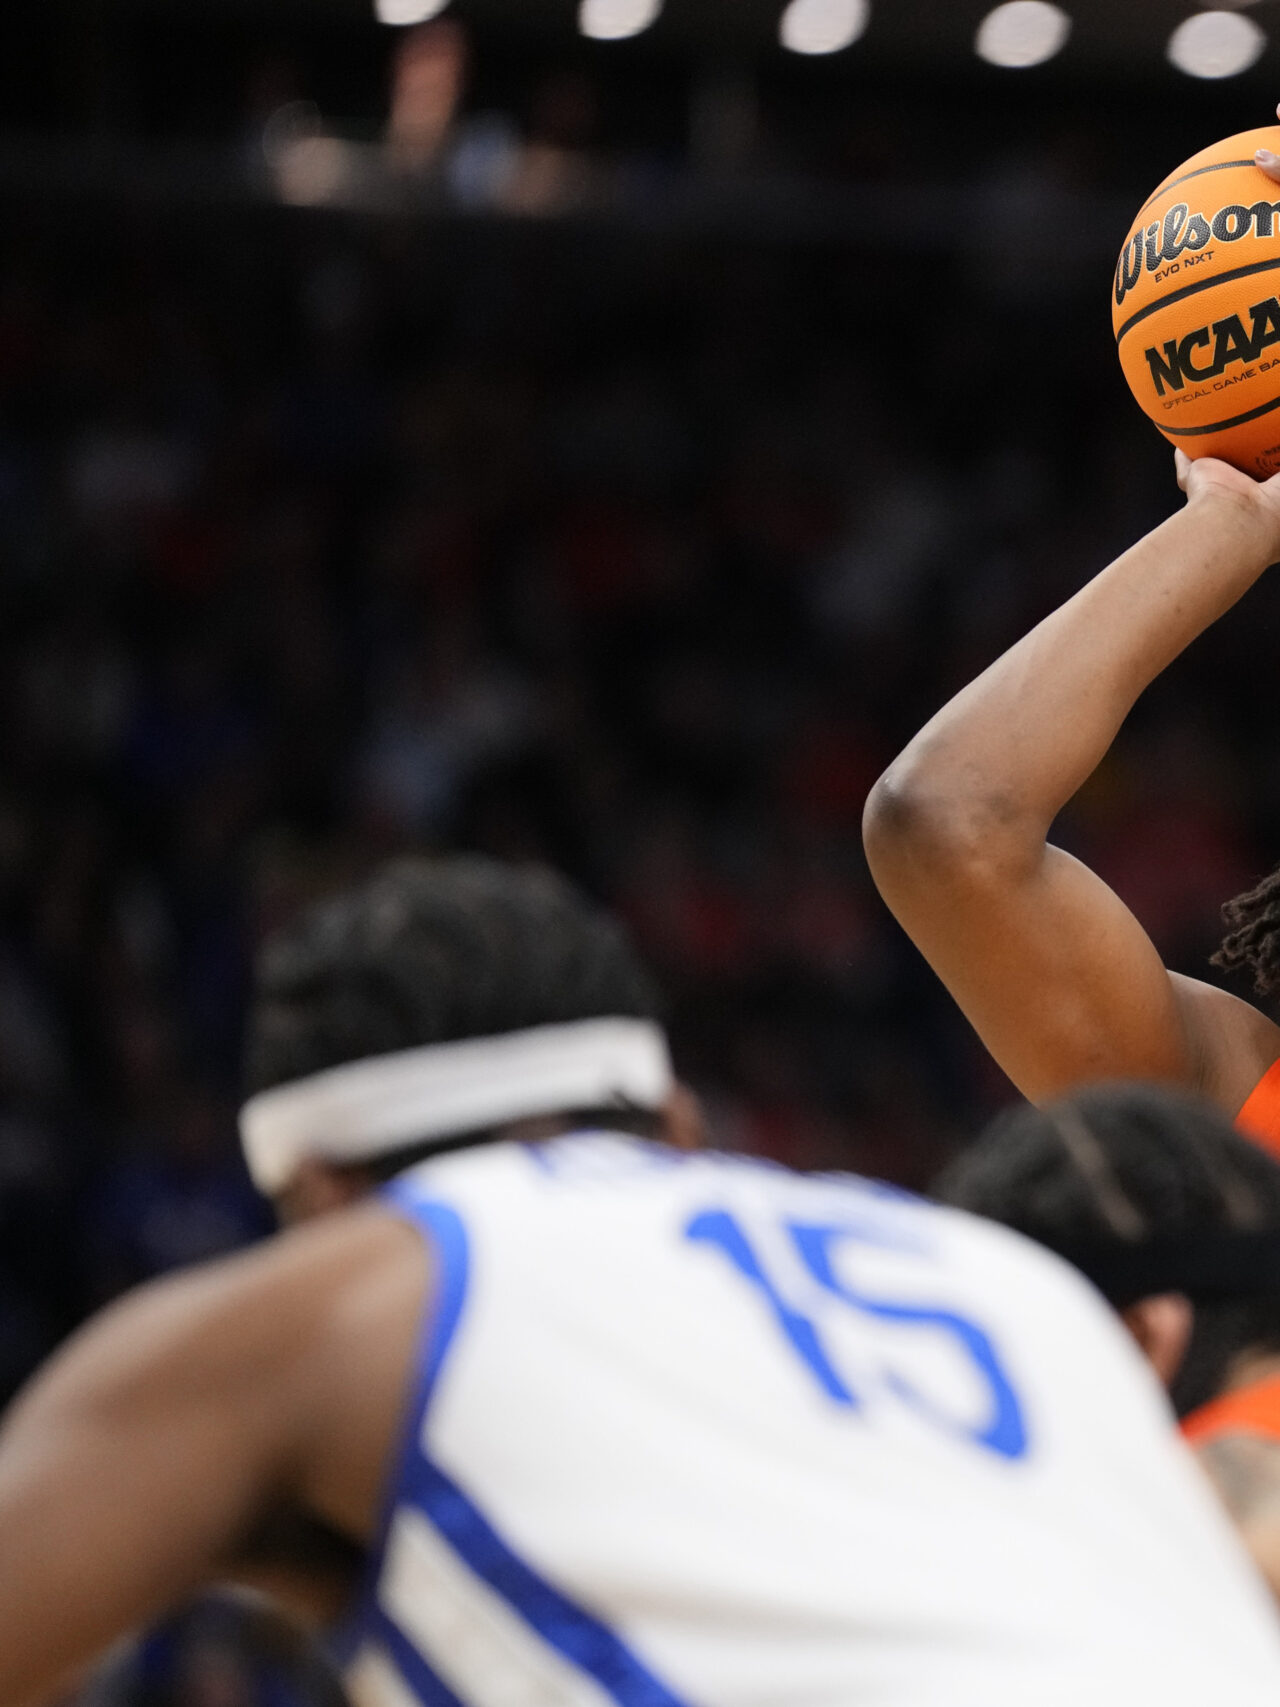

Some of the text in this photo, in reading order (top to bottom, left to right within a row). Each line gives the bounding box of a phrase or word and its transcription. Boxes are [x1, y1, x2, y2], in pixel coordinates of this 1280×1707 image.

[1154, 250, 1215, 283] EVO NXT
[1163, 388, 1211, 410] OFFICIAL
[1213, 368, 1257, 391] GAME
[684, 1208, 1030, 1461] 15
